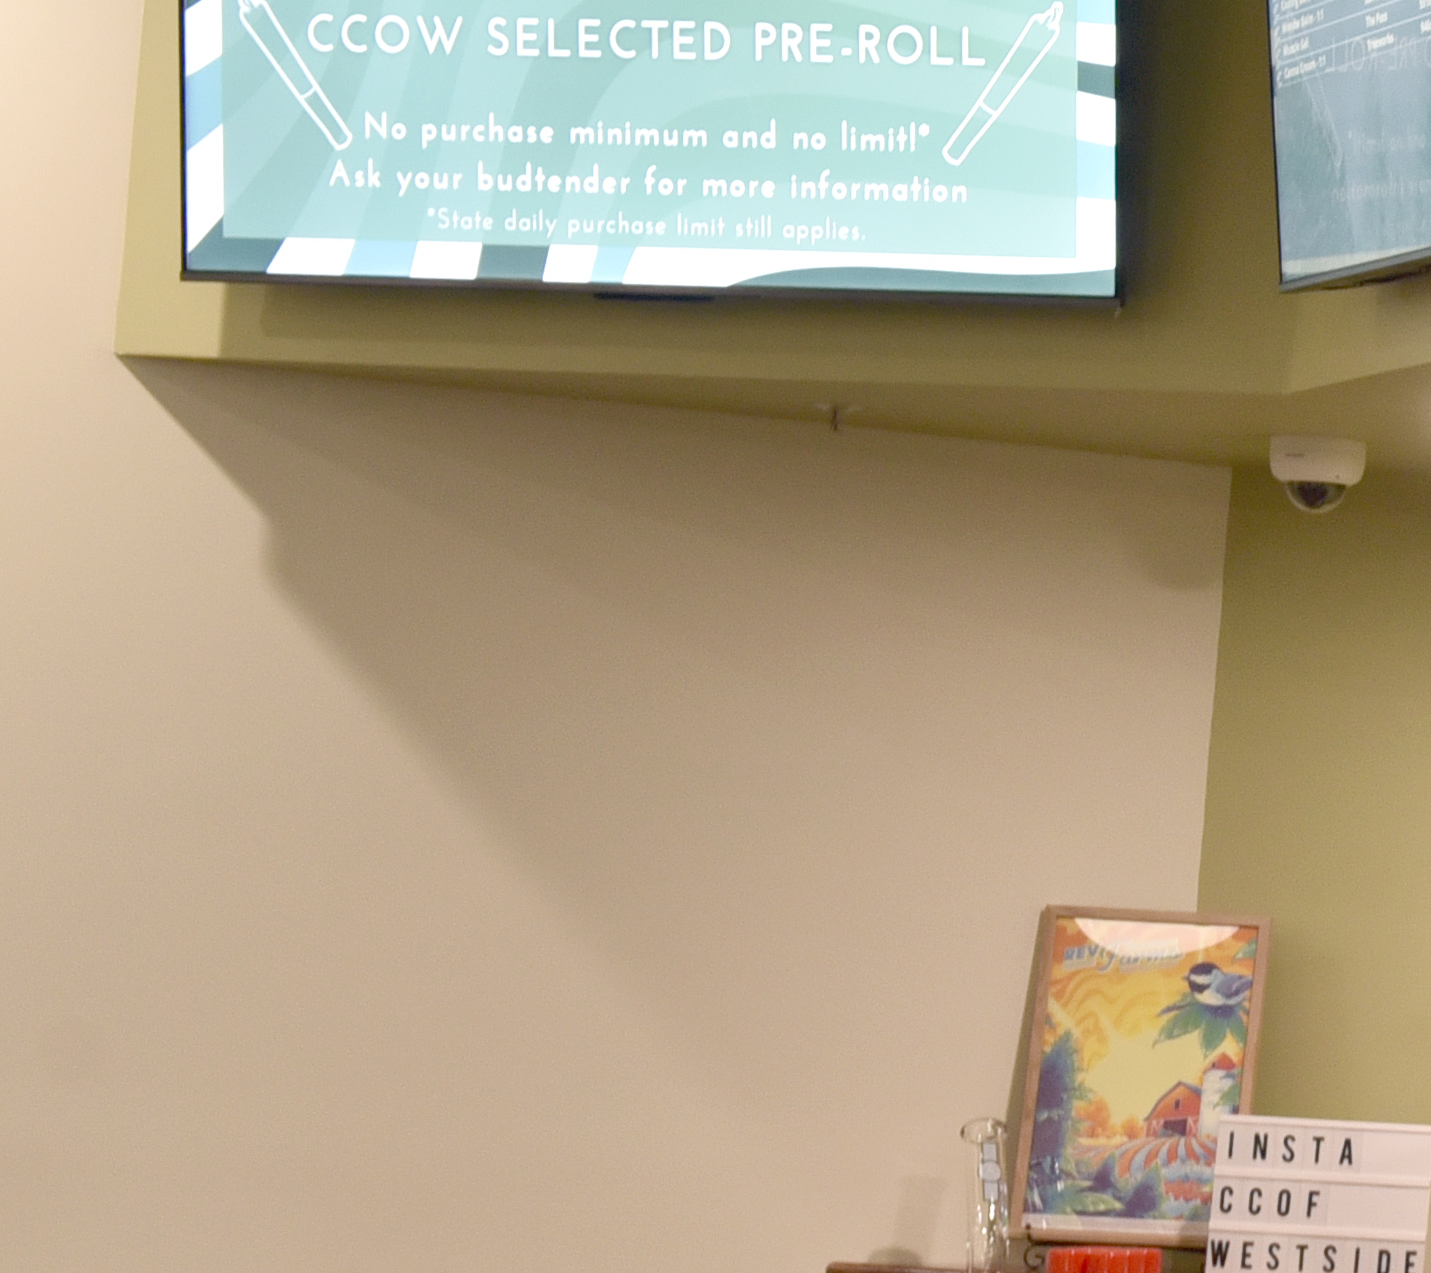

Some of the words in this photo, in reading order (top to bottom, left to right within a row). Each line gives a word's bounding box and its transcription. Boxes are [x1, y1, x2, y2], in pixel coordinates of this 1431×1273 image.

[308, 14, 462, 54] CCOW
[488, 17, 730, 60] SELECTED
[756, 22, 985, 66] PRE-ROLL
[365, 111, 406, 140] No
[422, 112, 554, 148] purchase
[571, 121, 707, 146] minimum
[723, 118, 776, 149] and
[794, 132, 826, 150] no
[330, 158, 380, 187] Ask
[397, 172, 463, 196] your
[478, 160, 630, 194] budtender
[645, 165, 687, 195] for
[703, 179, 775, 198] more
[791, 169, 967, 203] information
[505, 210, 556, 237] daily
[568, 212, 666, 238] purchase
[678, 213, 725, 236] limit
[736, 215, 771, 237] still
[783, 217, 865, 245] applies.
[1227, 1131, 1353, 1166] INSTA
[1219, 1186, 1320, 1218] CCOF
